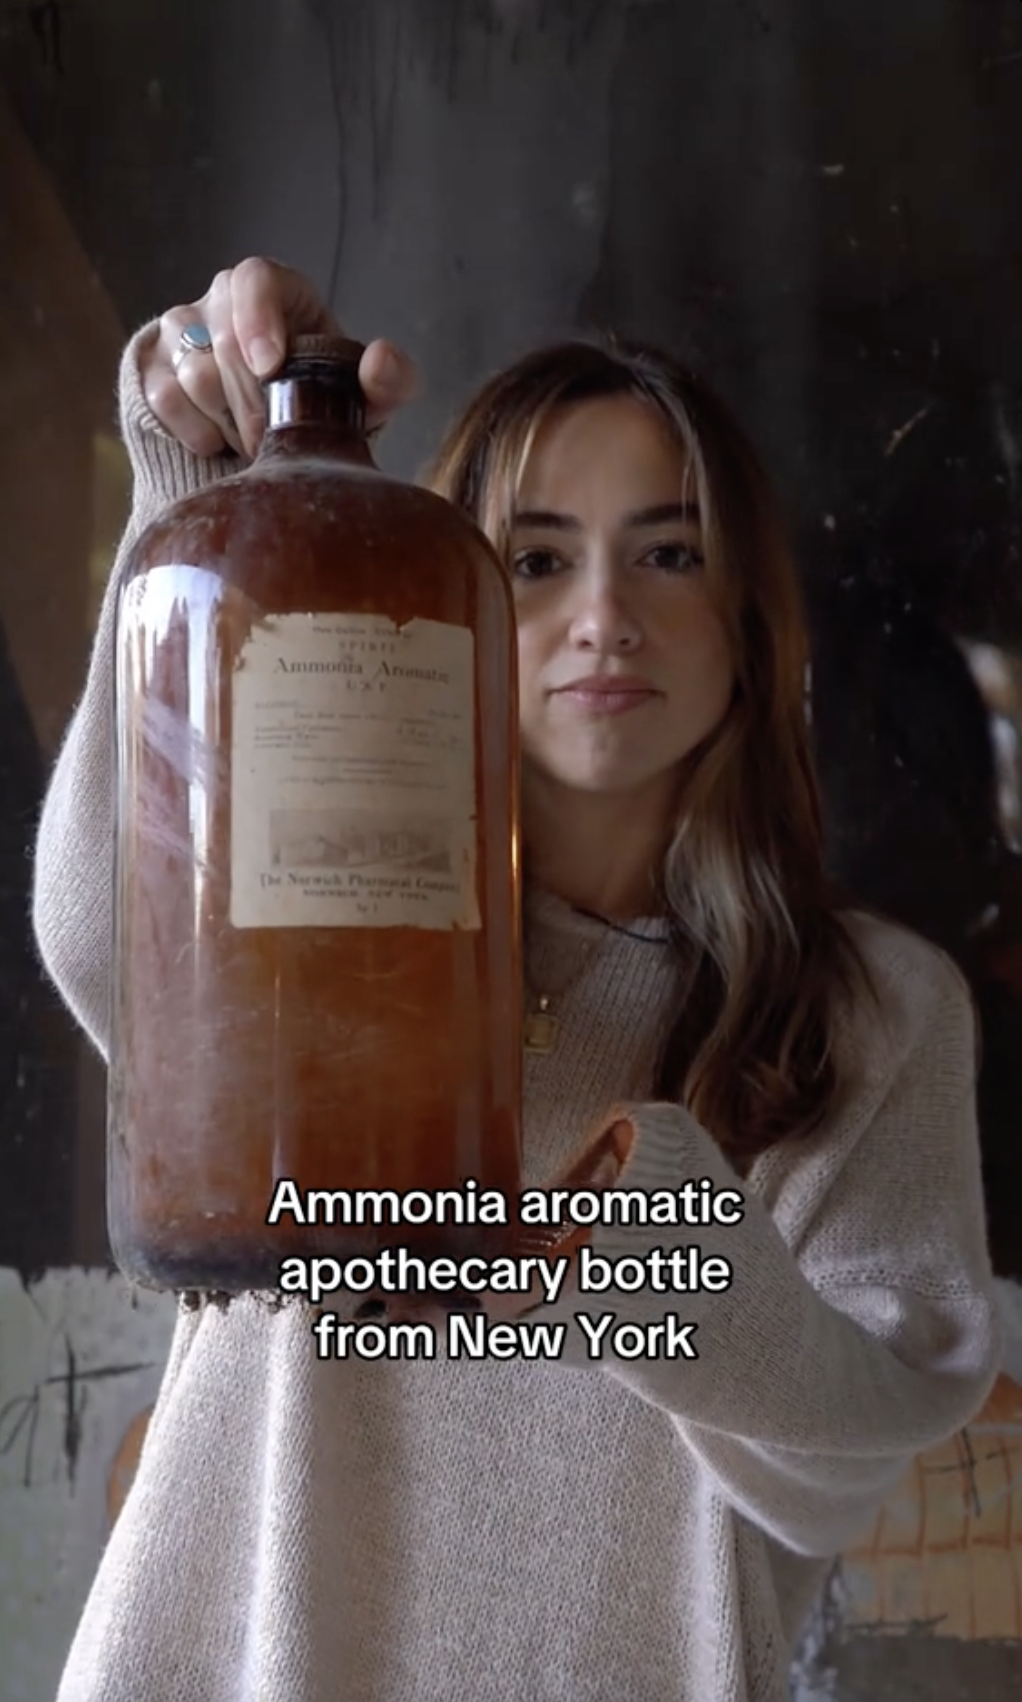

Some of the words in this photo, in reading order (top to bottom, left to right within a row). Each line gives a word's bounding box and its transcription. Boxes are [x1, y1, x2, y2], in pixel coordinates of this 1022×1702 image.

[273, 657, 364, 675] Ammonia
[259, 873, 282, 888] The
[287, 872, 342, 887] Norwich
